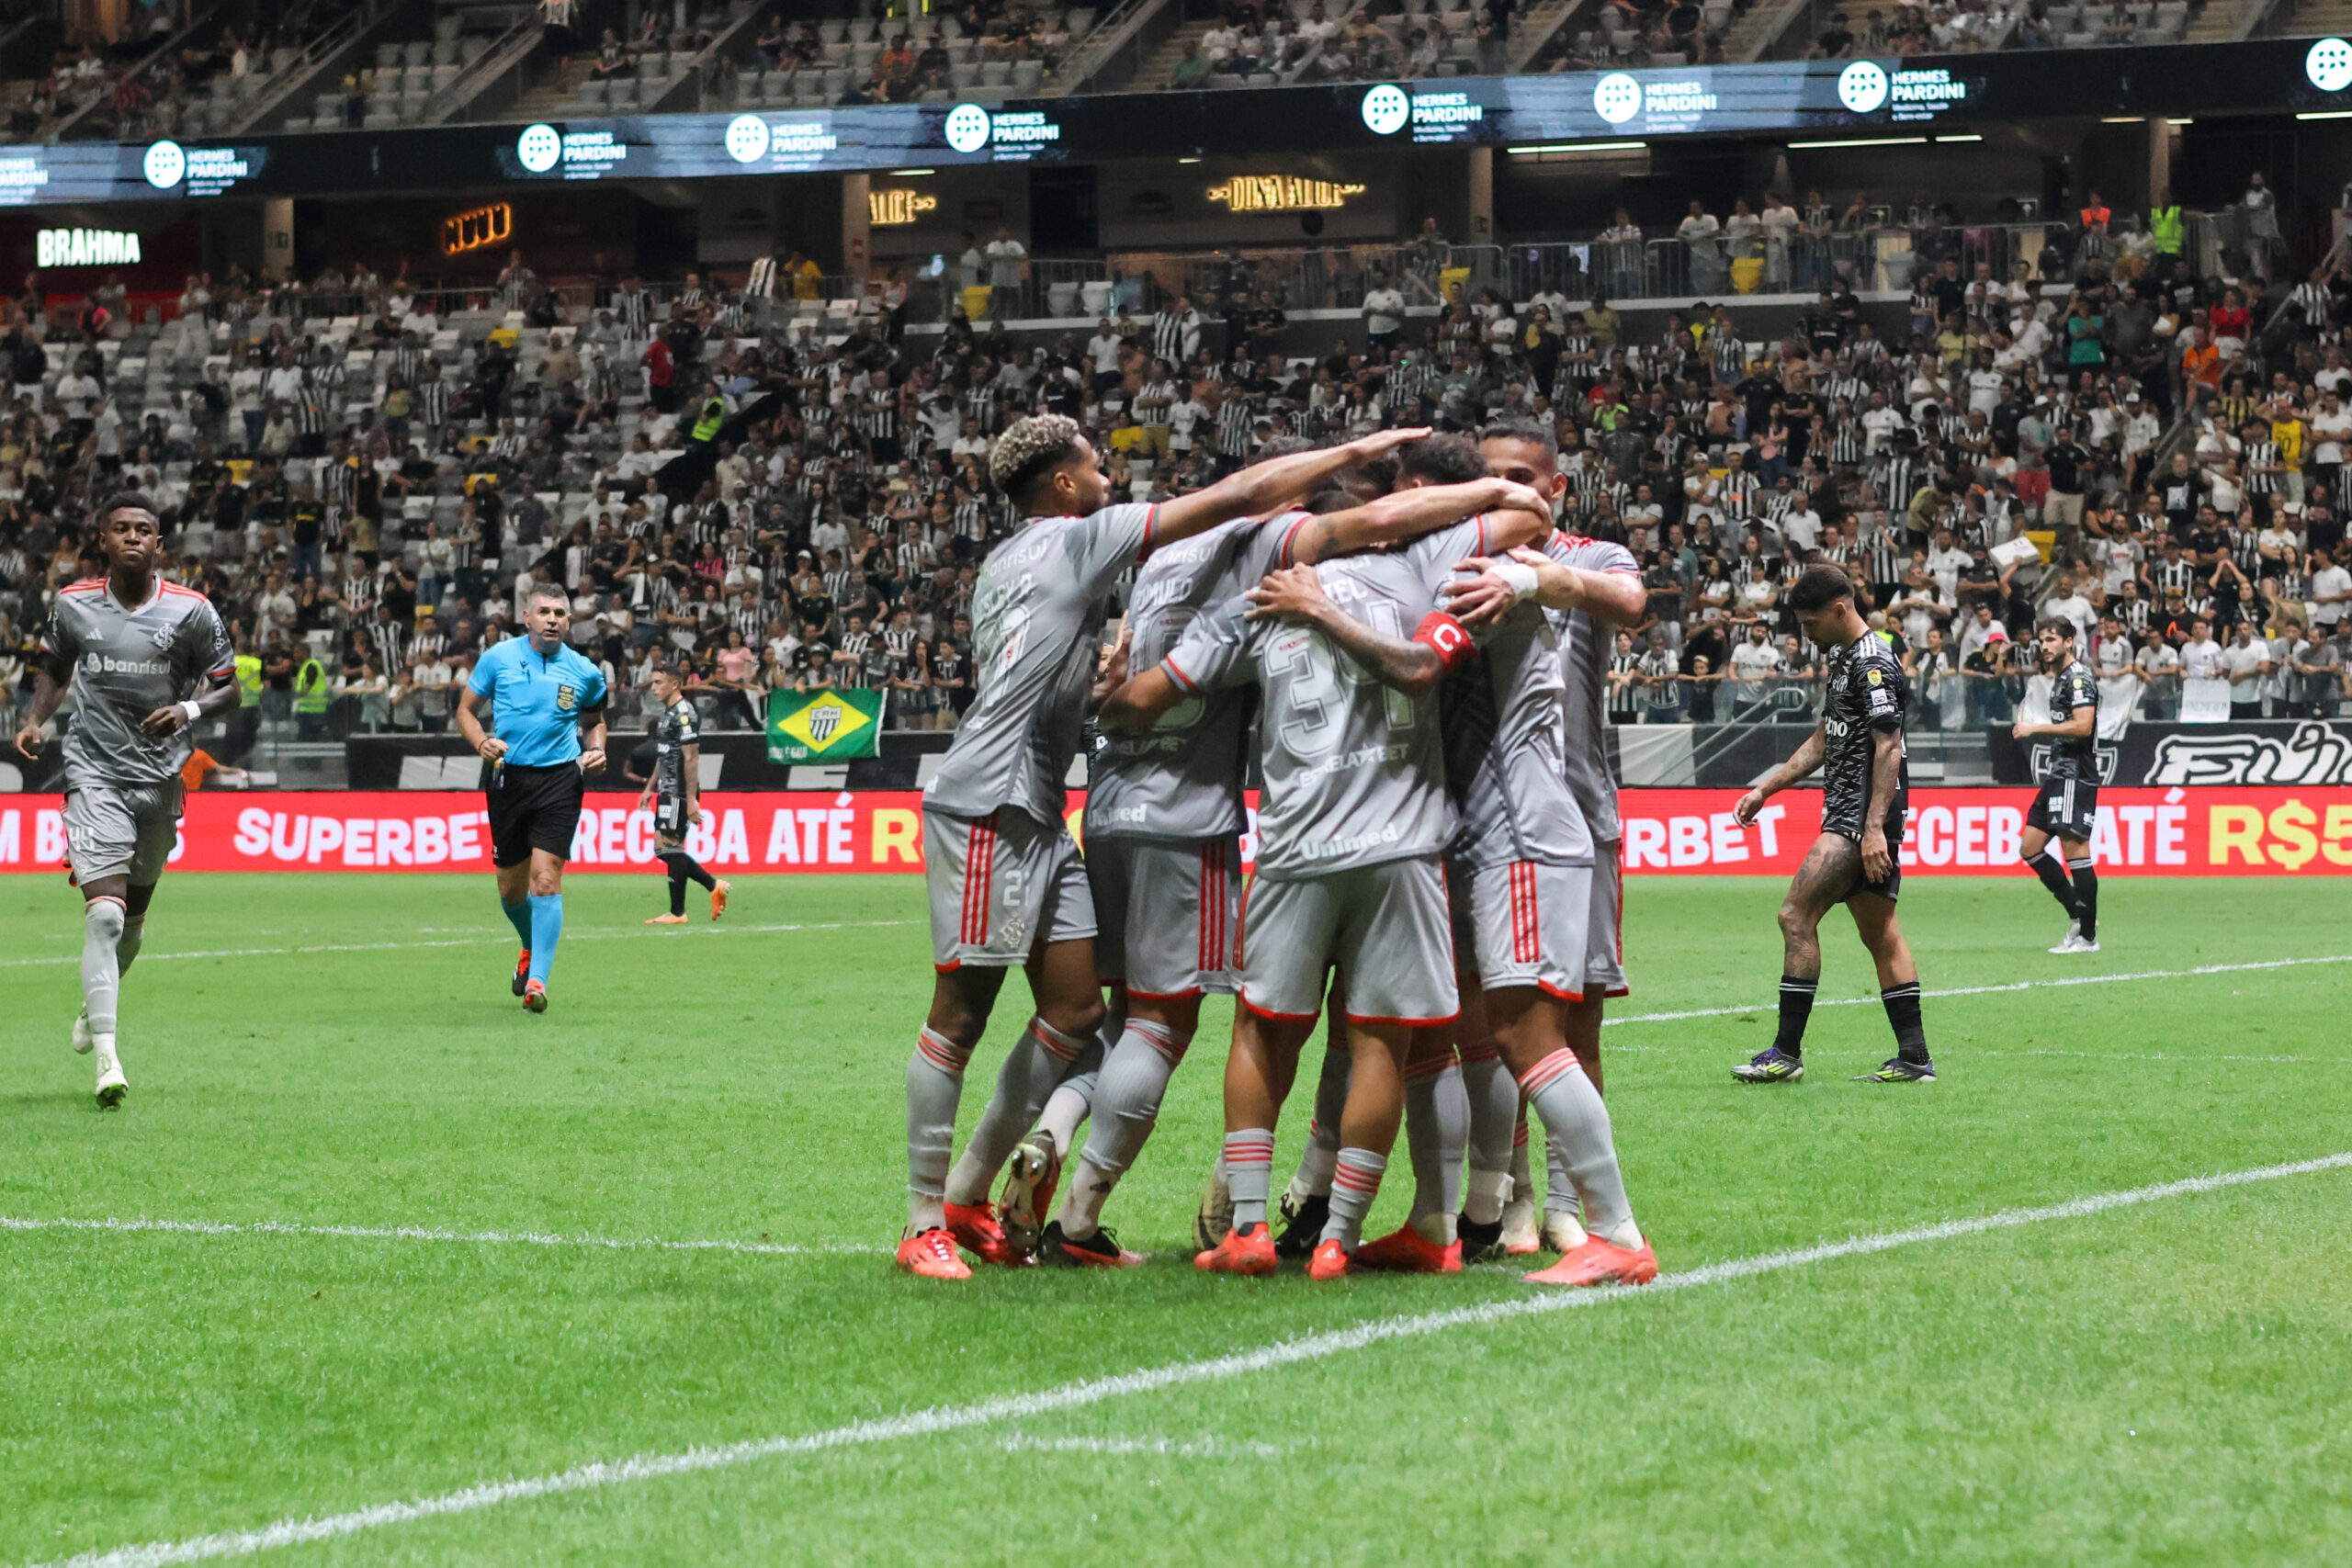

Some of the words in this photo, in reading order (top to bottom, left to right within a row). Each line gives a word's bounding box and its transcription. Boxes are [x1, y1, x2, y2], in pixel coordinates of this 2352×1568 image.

[1892, 70, 1950, 85] HERMES
[1645, 81, 1702, 96] HERMES
[1892, 83, 1965, 101] PARDINI
[1412, 92, 1468, 107] HERMES
[1645, 94, 1717, 112] PARDINI
[992, 112, 1046, 126] HERMES
[1412, 105, 1483, 123] PARDINI
[563, 132, 613, 146] HERMES
[772, 123, 823, 137] HERMES
[992, 124, 1059, 141] PARDINI
[772, 135, 837, 152] PARDINI
[187, 149, 234, 163] HERMES
[563, 144, 627, 162] PARDINI
[187, 161, 247, 178] PARDINI
[38, 229, 141, 267] BRAHMA
[1433, 623, 1462, 652] C
[104, 655, 171, 674] banrisul
[570, 808, 750, 863] RECBA
[765, 792, 854, 863] ATÉ
[2091, 788, 2187, 865] ATÉ
[234, 807, 488, 865] SUPERBE
[1301, 822, 1399, 861] Unimed
[1620, 805, 1785, 868] RBET
